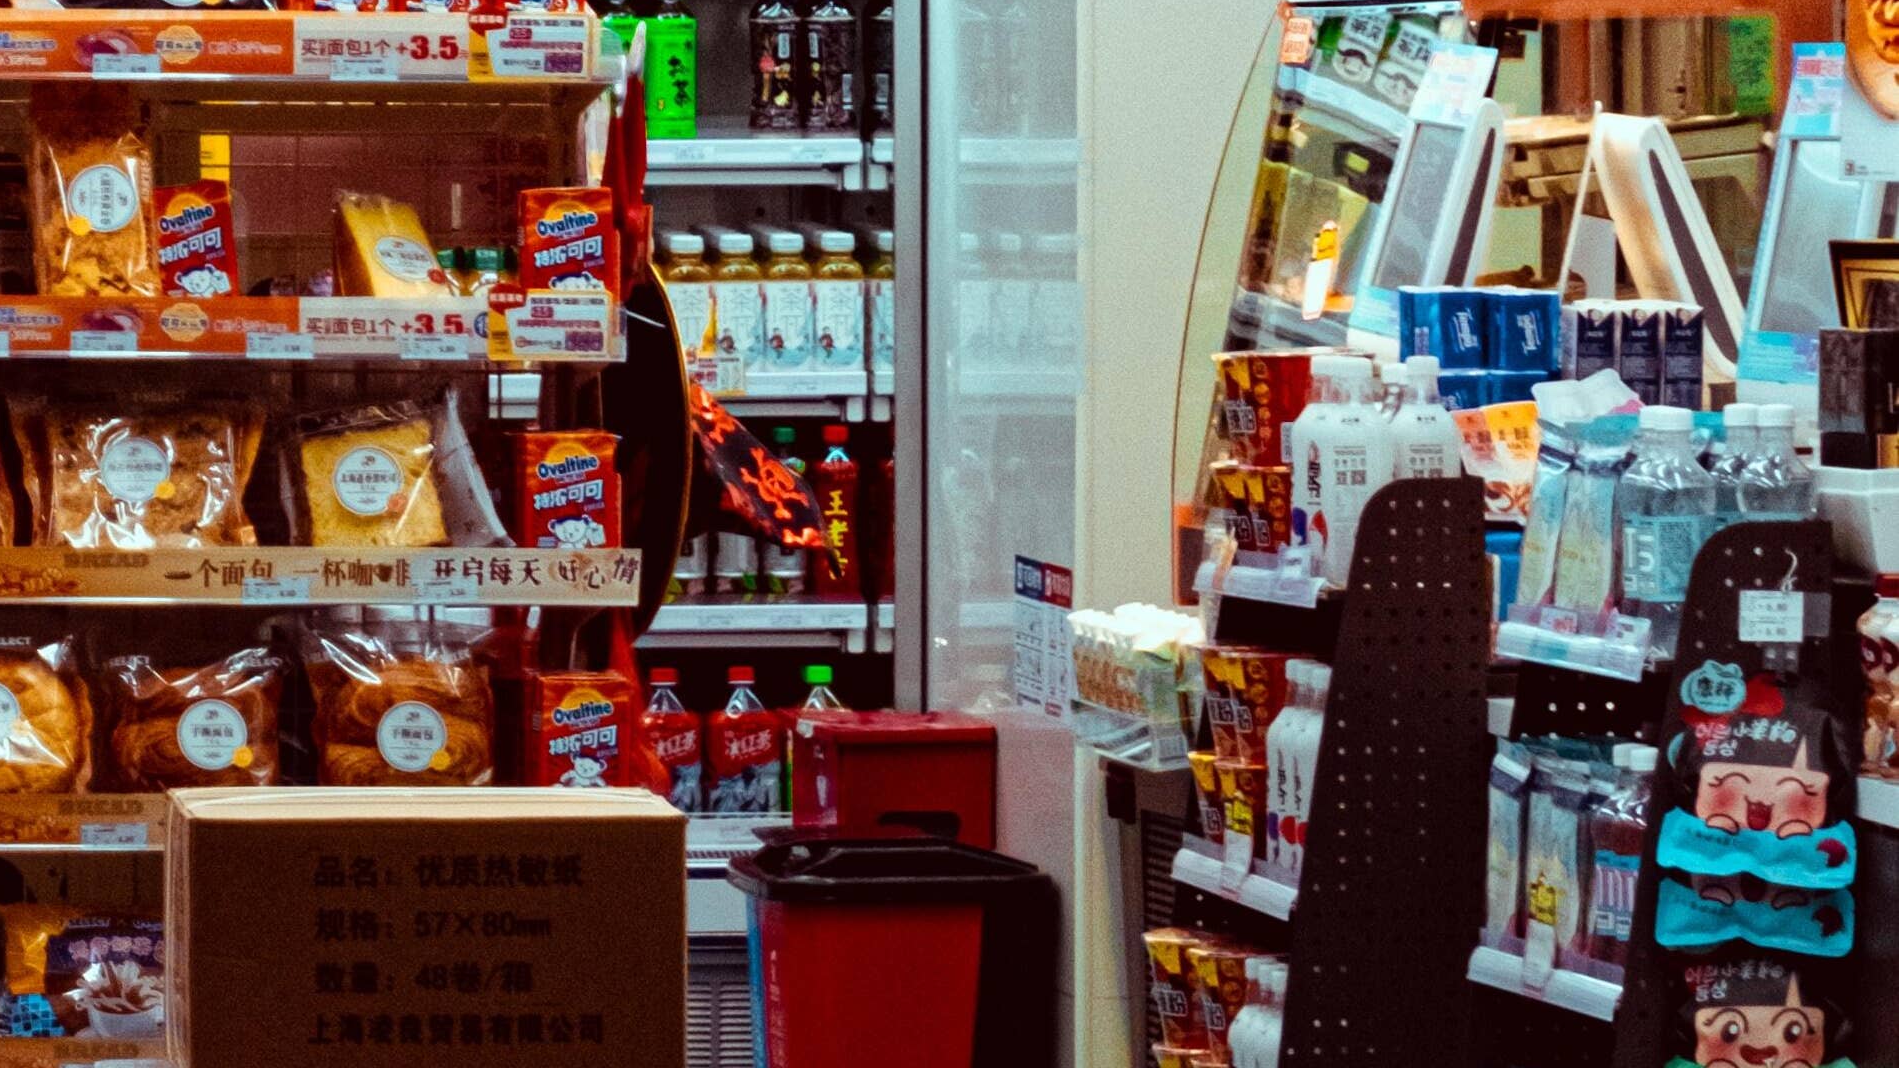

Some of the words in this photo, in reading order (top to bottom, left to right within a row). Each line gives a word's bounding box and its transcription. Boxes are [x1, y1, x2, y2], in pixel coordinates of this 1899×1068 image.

[536, 211, 597, 236] Ovaltine
[538, 456, 598, 478] Ovaltine
[553, 700, 613, 726] Ovaltine
[724, 729, 772, 757] 冰红茶
[414, 854, 585, 888] 优质热敏纸
[414, 960, 534, 994] 48卷/箱
